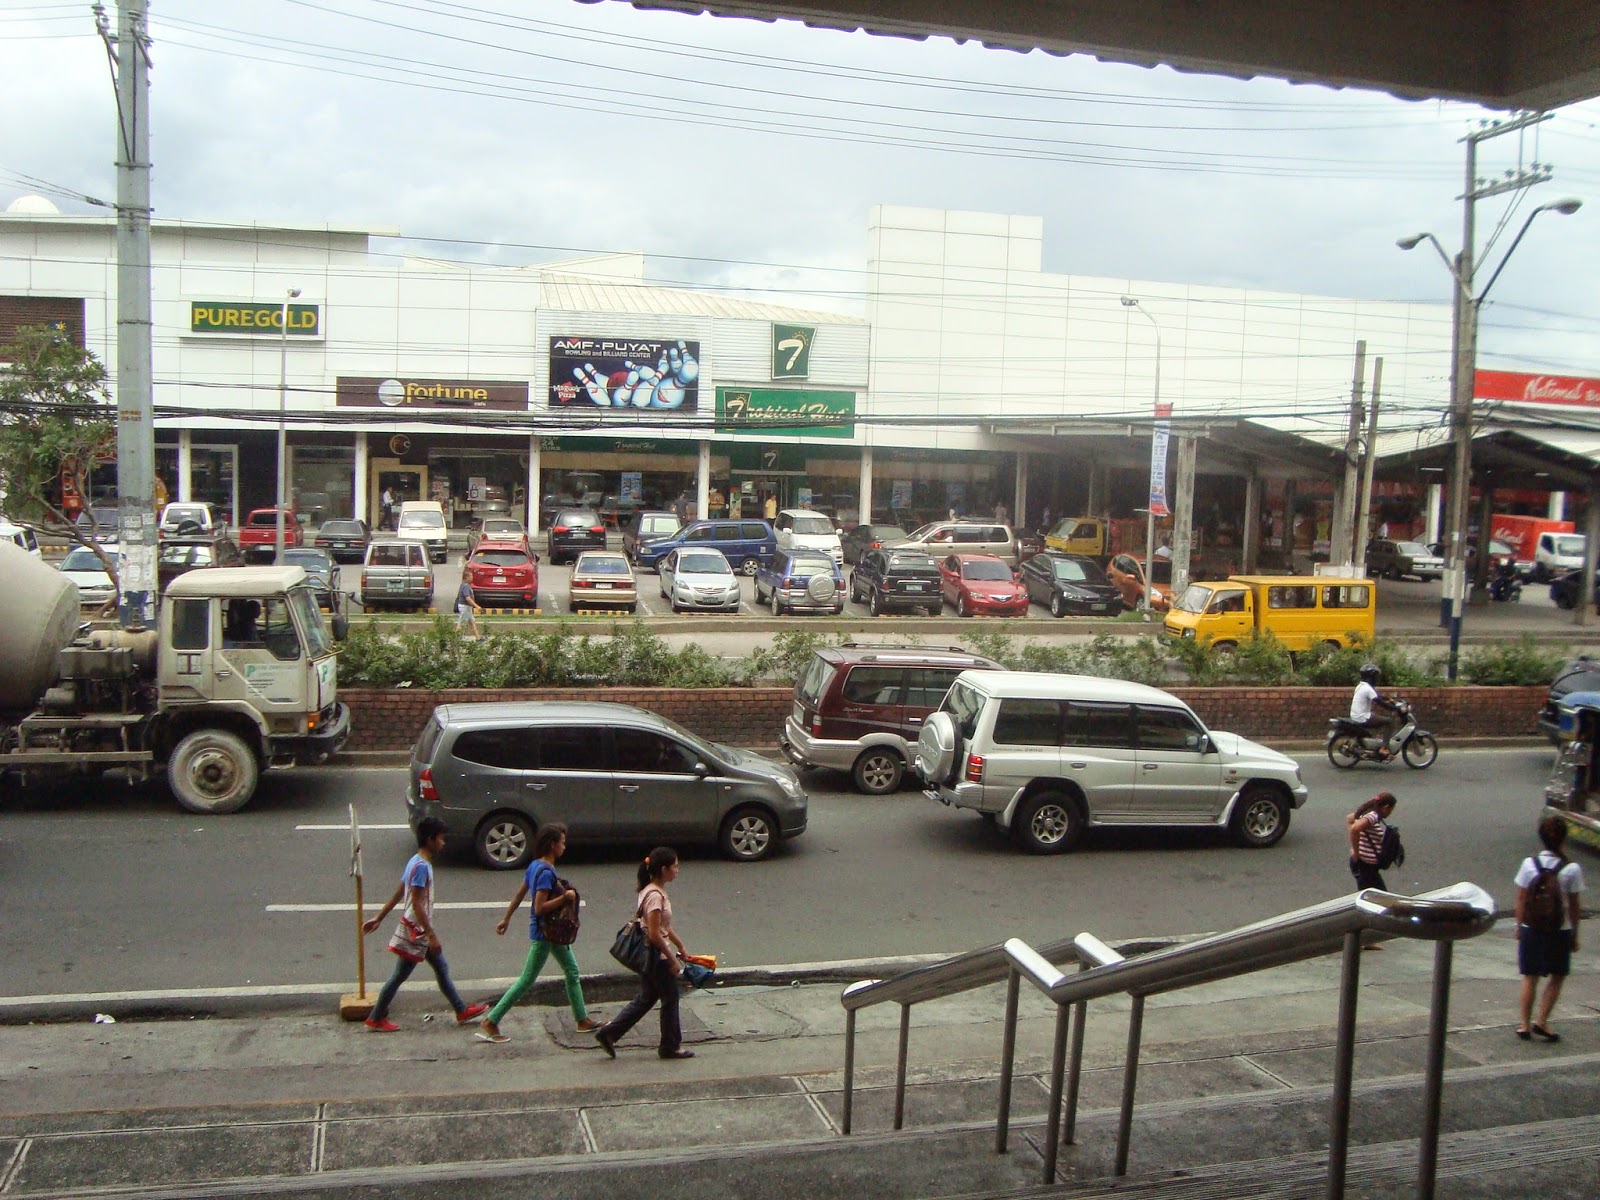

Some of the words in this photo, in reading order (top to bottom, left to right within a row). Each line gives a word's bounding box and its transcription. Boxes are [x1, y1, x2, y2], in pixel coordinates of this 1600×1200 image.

[193, 307, 317, 328] PUREGOLD
[554, 341, 662, 352] AMF-PUYAT
[564, 348, 590, 356] BOWLING
[628, 351, 651, 359] CENTER
[407, 382, 488, 403] fortune
[1523, 376, 1586, 401] National
